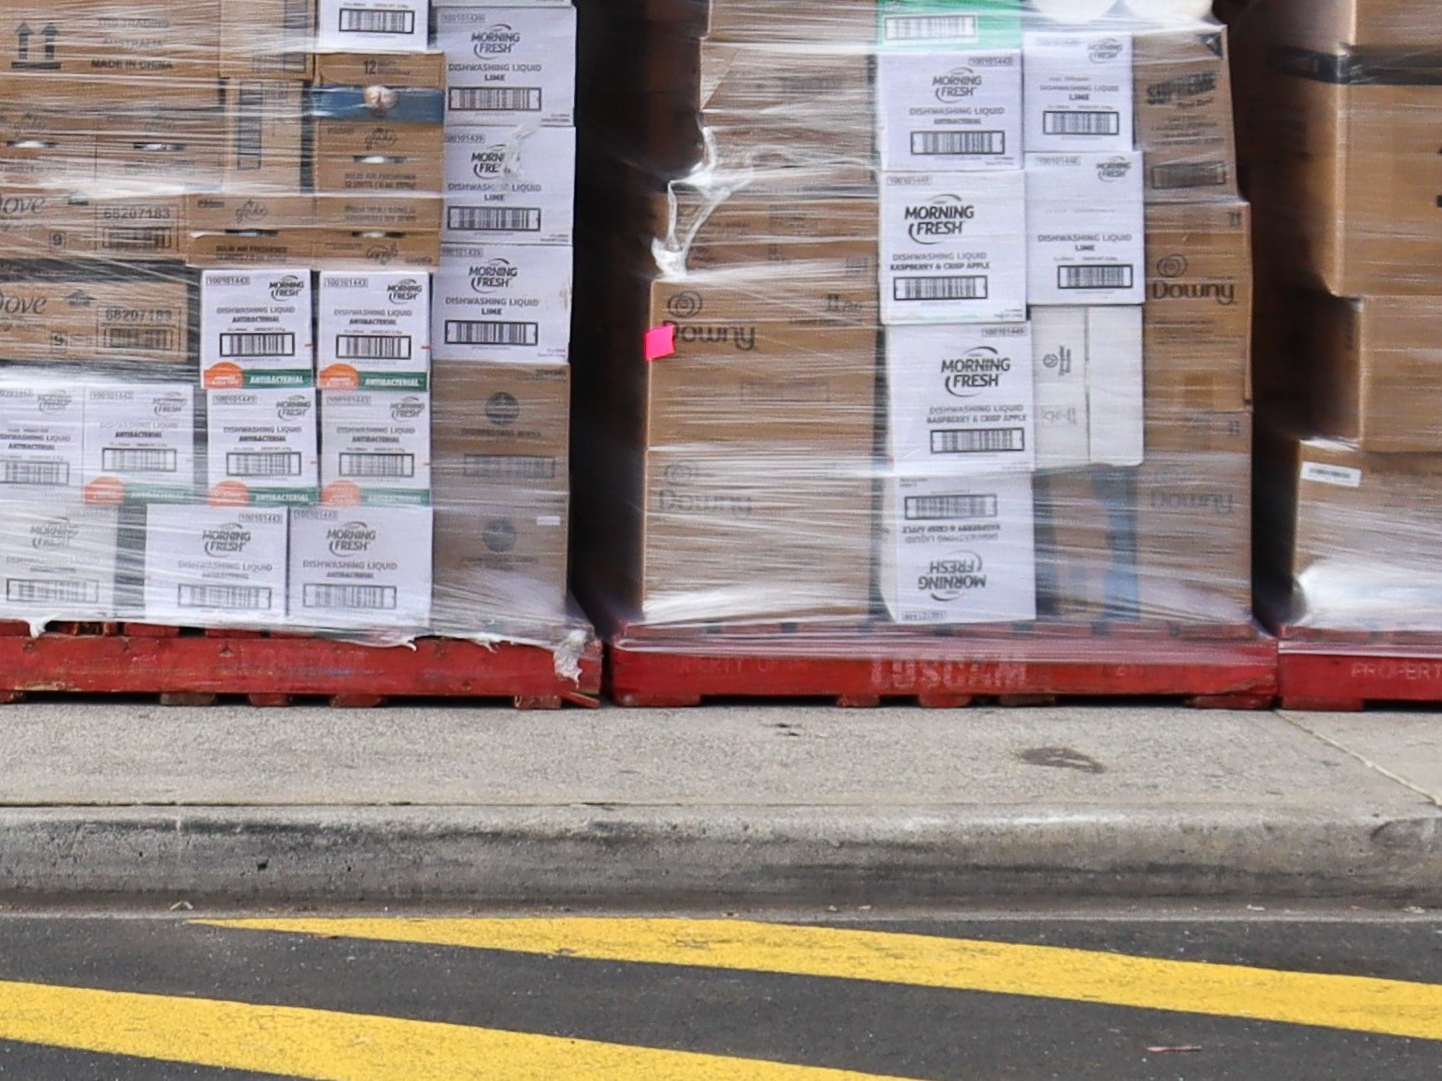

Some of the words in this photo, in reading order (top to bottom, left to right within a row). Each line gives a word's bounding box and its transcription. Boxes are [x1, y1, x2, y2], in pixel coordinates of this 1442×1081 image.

[471, 32, 520, 42] MORNING
[479, 43, 512, 53] FRESH
[91, 59, 126, 69] MADE
[364, 60, 376, 75] 12
[449, 64, 510, 72] DISHWASHING
[512, 64, 541, 72] LIQUID
[484, 73, 505, 81] LIME
[932, 76, 982, 86] MORNING
[941, 88, 974, 96] FRESH
[909, 107, 971, 115] DISHWASHING
[974, 107, 1004, 115] LIQUID
[1096, 163, 1131, 171] MORNING
[512, 184, 541, 192] LIQUID
[904, 206, 974, 220] MORNING
[917, 222, 962, 235] FRESH
[1037, 234, 1100, 242] DISHWASHING
[1102, 234, 1132, 242] LIQUID
[957, 253, 987, 261] LIQUID
[890, 263, 933, 271] RASPBERRY
[943, 263, 964, 271] CRISP
[966, 262, 990, 270] APPLE
[469, 267, 517, 277] MORNING
[269, 281, 304, 289] MORNING
[476, 278, 509, 287] FRESH
[1152, 280, 1236, 305] Downy
[446, 298, 506, 306] DISHWASHING
[509, 299, 539, 307] LIQUID
[941, 358, 1011, 372] MORNING
[250, 376, 303, 384] ANTIBACTERIAL
[365, 379, 419, 387] ANTIBACTERIAL
[953, 375, 999, 387] FRESH
[929, 405, 991, 413] DISHWASHING
[993, 405, 1024, 413] LIQUID
[926, 415, 970, 423] RASPBERRY
[1002, 415, 1027, 423] APPLE
[203, 531, 251, 541] MORNING
[327, 530, 376, 540] MORNING
[210, 542, 242, 552] FRESH
[335, 541, 366, 550] FRESH
[303, 561, 364, 569] DISHWASHING
[367, 562, 397, 570] LIQUID
[930, 560, 975, 574] FRESH
[918, 575, 986, 590] MORNING
[870, 659, 1025, 689] LOSCAM
